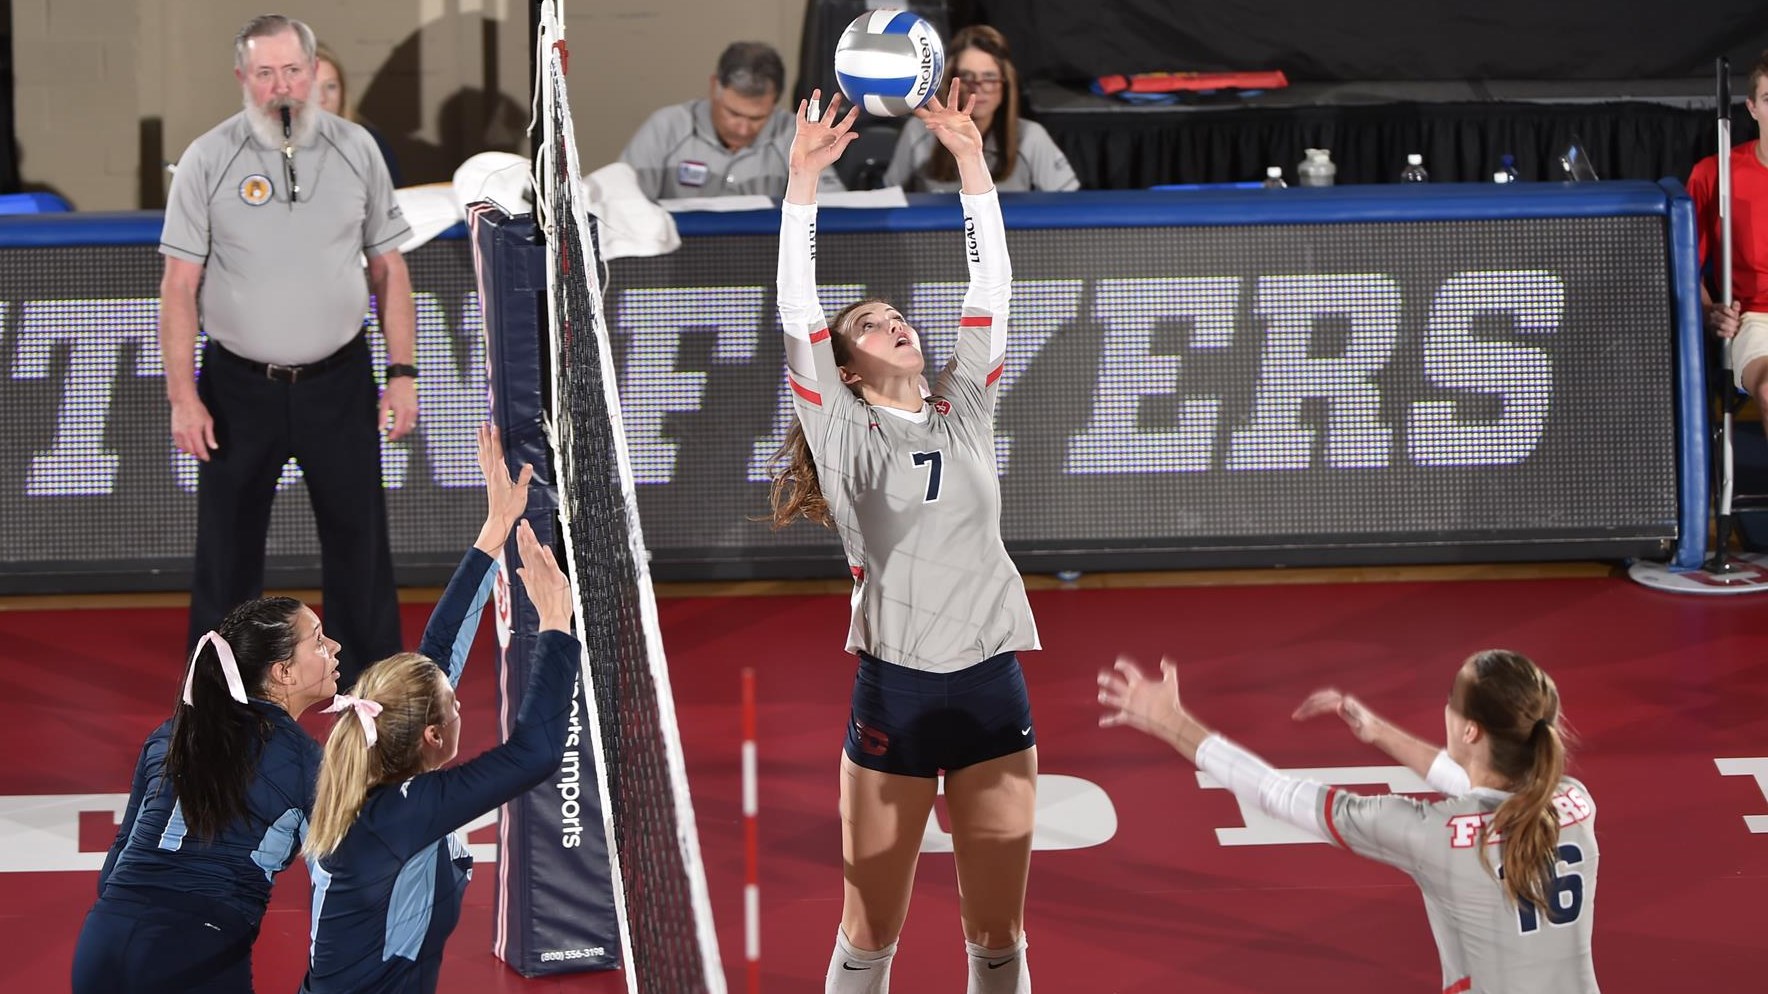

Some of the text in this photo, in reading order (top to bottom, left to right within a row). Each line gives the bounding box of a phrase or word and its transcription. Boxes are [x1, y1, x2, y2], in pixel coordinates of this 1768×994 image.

[916, 37, 931, 96] molten
[964, 215, 980, 263] LEGACY
[909, 450, 942, 503] 7
[556, 751, 583, 849] imports
[541, 947, 604, 962] (800) 556-3198
